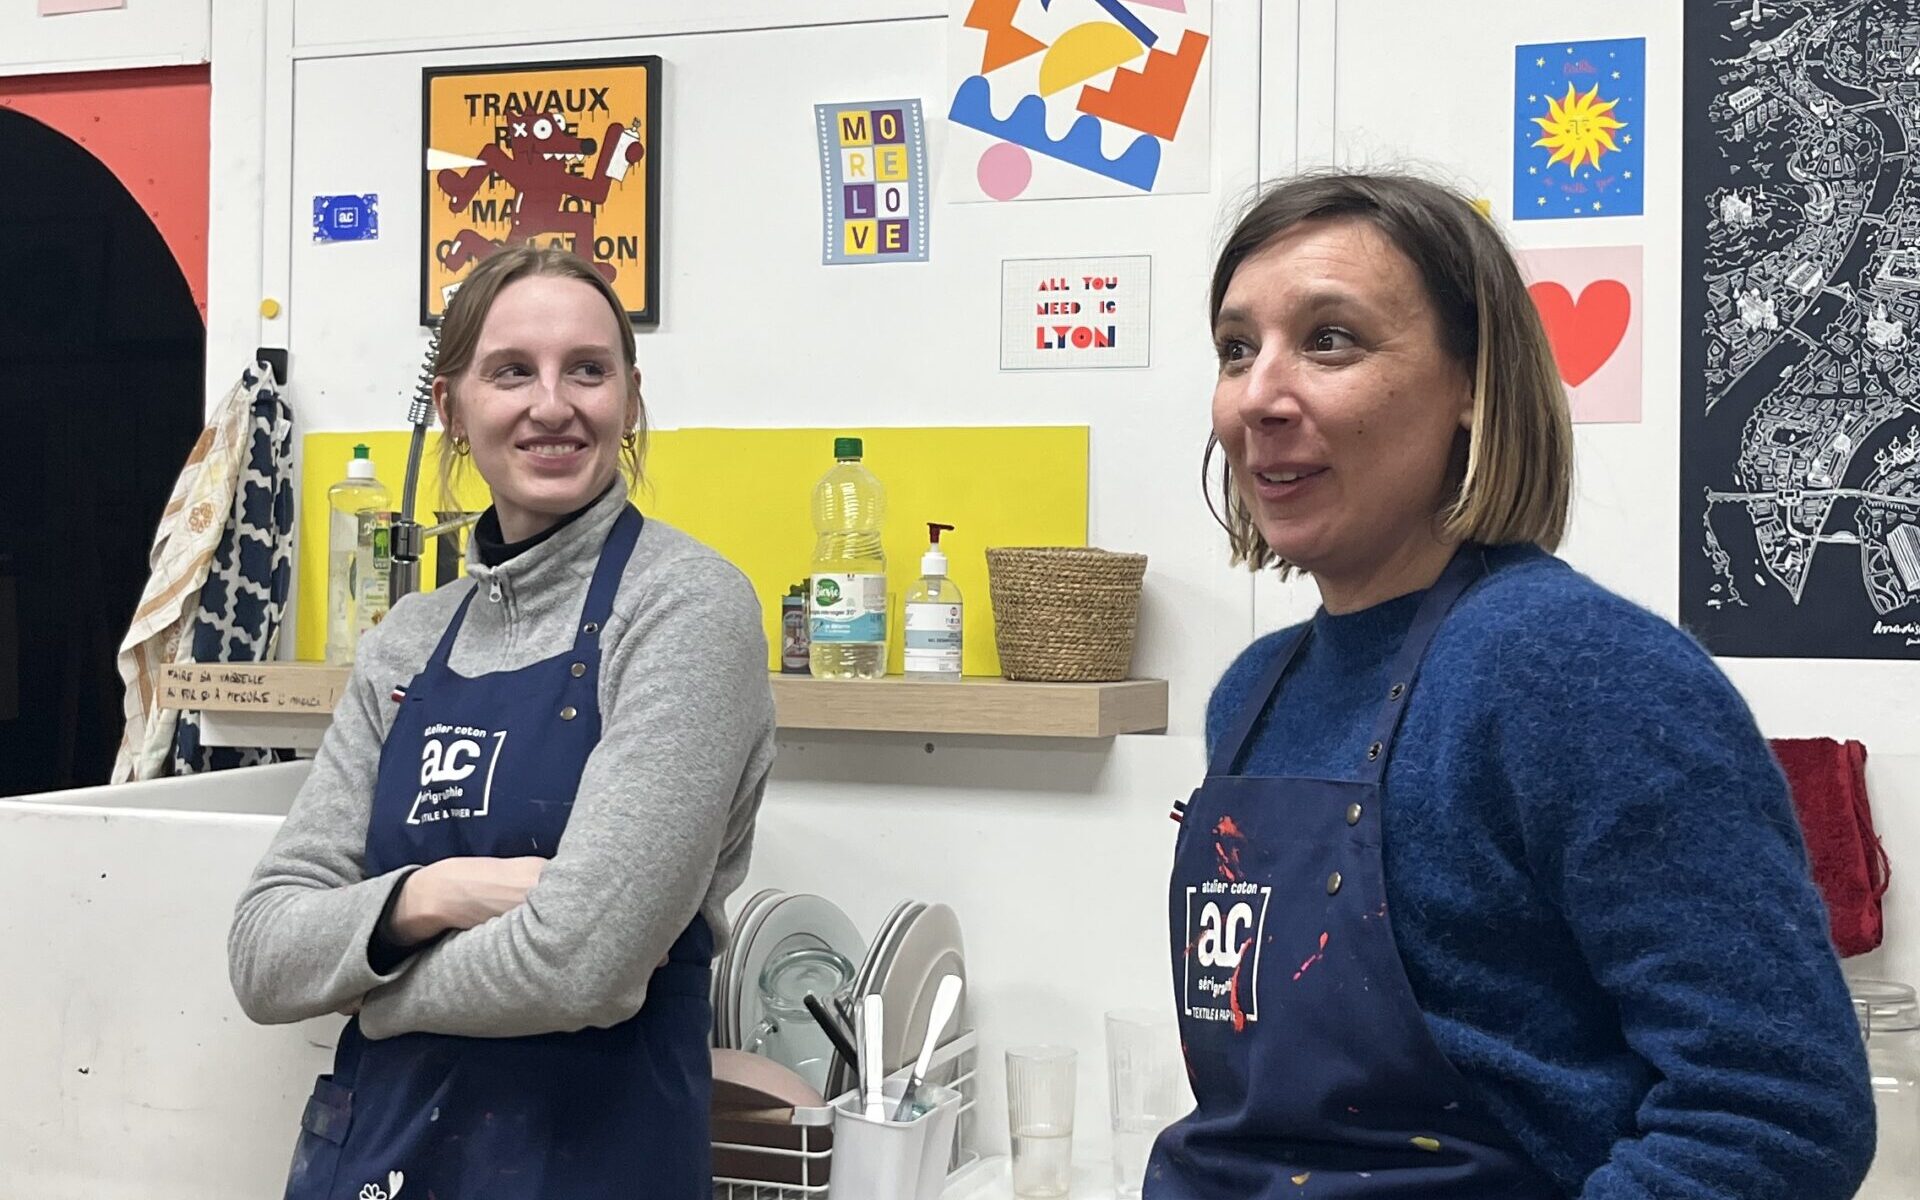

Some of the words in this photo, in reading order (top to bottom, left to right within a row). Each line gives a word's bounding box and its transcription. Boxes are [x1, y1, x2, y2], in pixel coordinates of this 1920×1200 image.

[464, 88, 610, 117] TRAVAUX
[338, 212, 354, 223] ac
[1038, 277, 1070, 292] ALL
[1082, 276, 1118, 290] YOU
[1037, 302, 1081, 315] NEED
[1036, 325, 1116, 350] LYON
[454, 726, 487, 738] coton
[421, 739, 481, 787] ac
[1201, 878, 1229, 894] atelier
[1230, 880, 1258, 894] coton
[1198, 901, 1253, 968] ac
